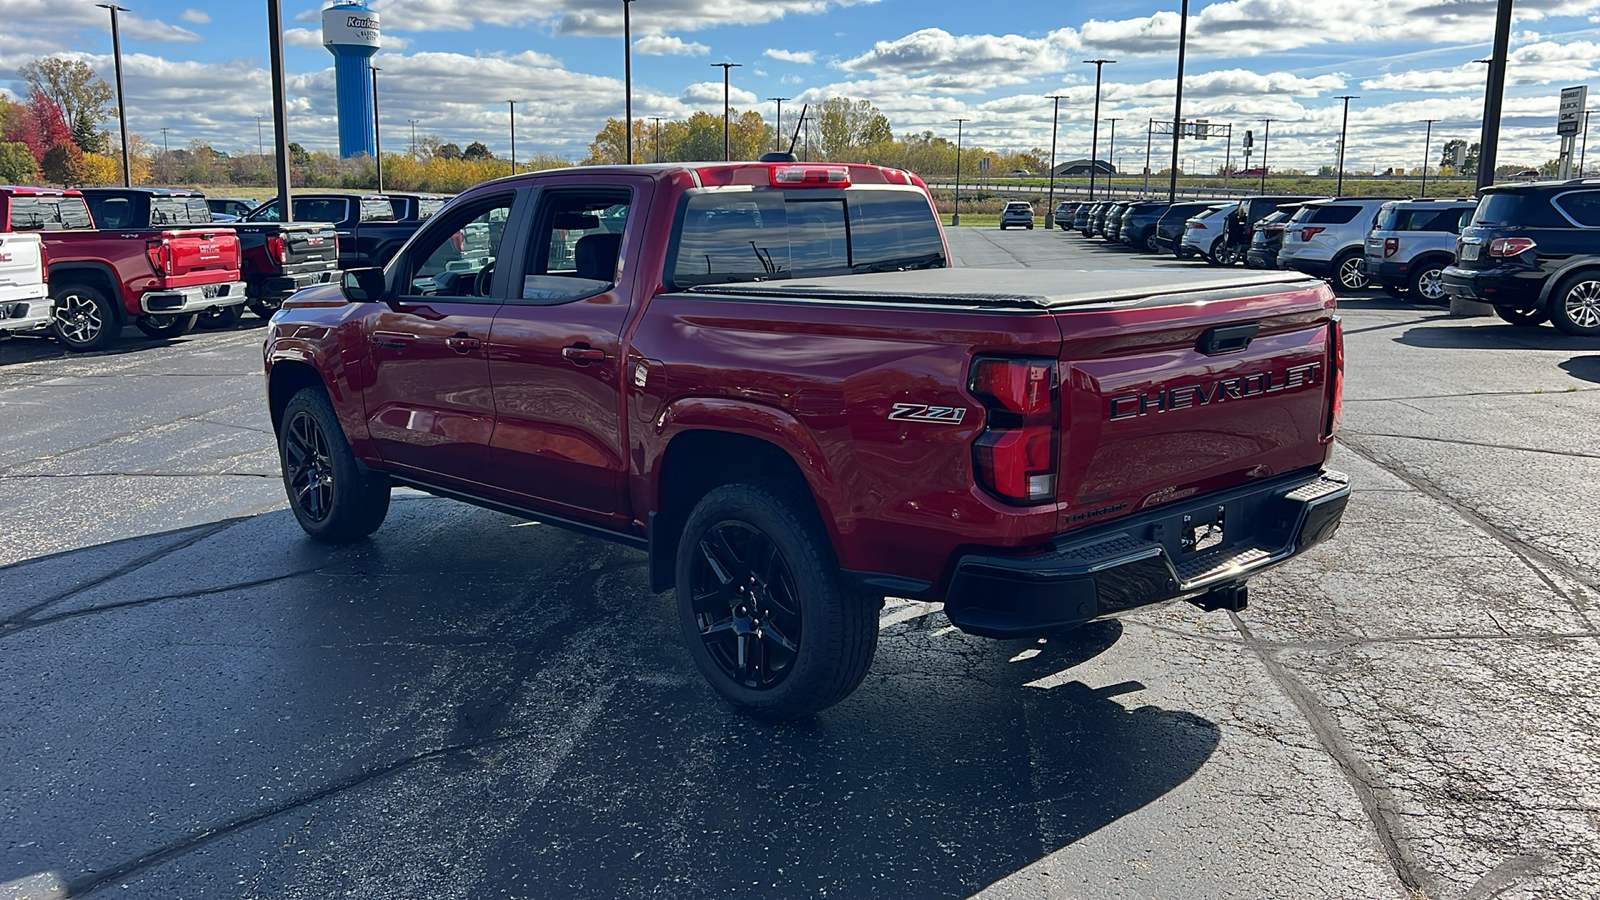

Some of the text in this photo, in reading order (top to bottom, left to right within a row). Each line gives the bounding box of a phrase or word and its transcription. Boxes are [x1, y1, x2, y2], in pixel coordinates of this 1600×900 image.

[1560, 102, 1578, 110] BUICK
[1109, 361, 1321, 422] CHEVROLET
[887, 402, 968, 425] Z71
